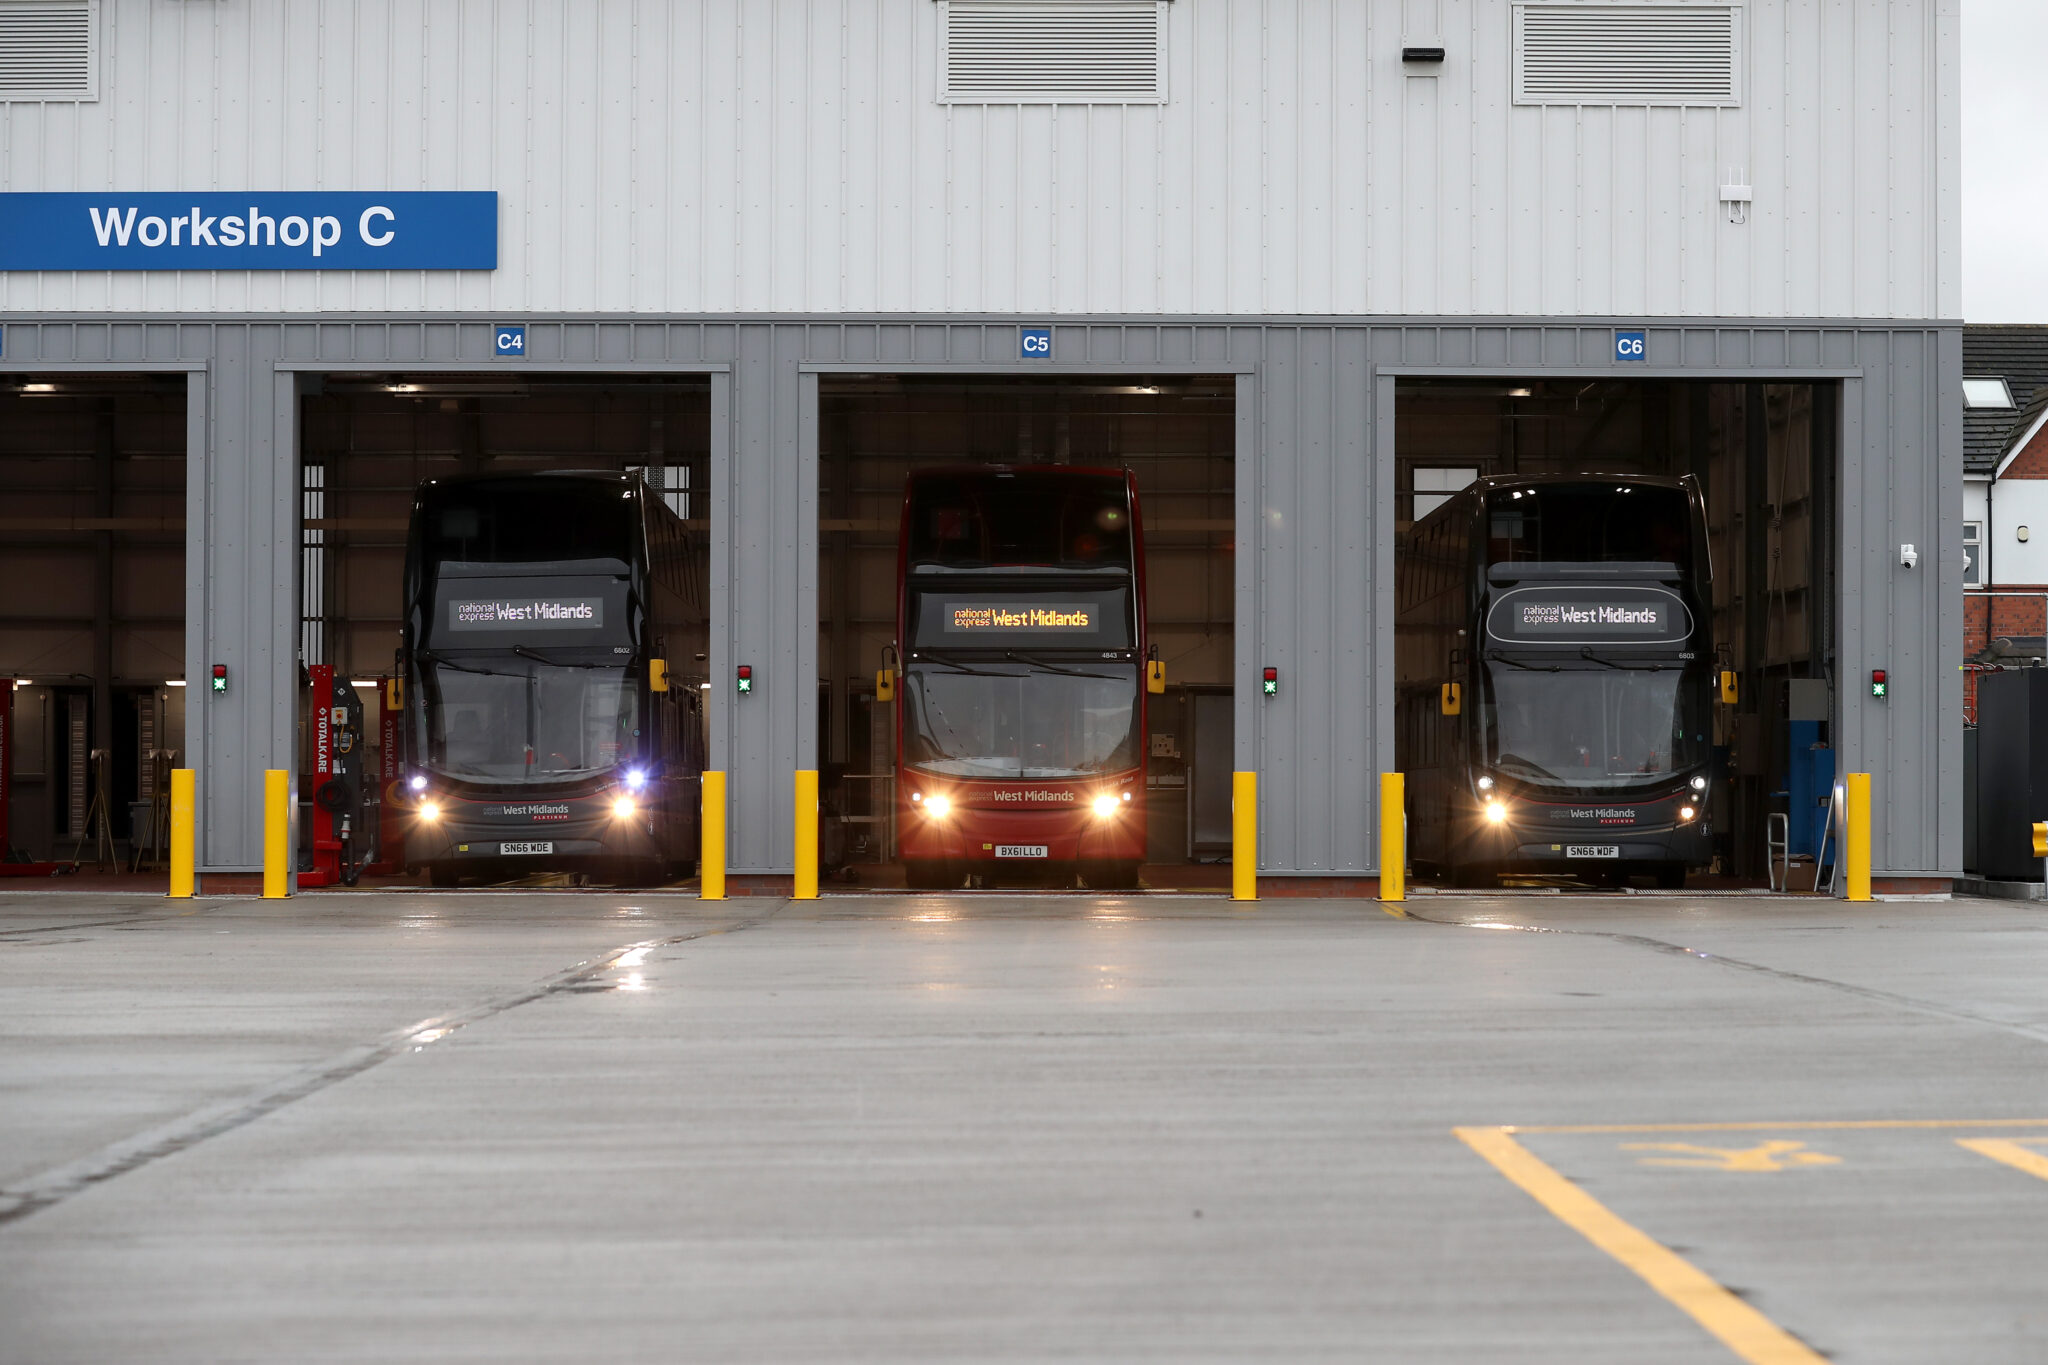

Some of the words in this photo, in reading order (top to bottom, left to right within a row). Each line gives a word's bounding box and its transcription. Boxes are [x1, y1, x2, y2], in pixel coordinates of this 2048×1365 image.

[89, 207, 341, 256] Workshop
[359, 206, 395, 246] C
[498, 333, 522, 349] C4
[1023, 336, 1048, 351] C5
[1618, 339, 1642, 354] C6
[458, 602, 494, 612] national
[496, 603, 532, 620] West
[534, 602, 593, 619] Midlands
[1523, 605, 1560, 615] national
[458, 612, 495, 623] express
[954, 608, 990, 618] national
[992, 609, 1028, 626] West
[1030, 609, 1088, 626] Midlands
[1561, 606, 1596, 623] West
[1599, 606, 1656, 623] Midlands
[954, 618, 990, 628] express
[1523, 615, 1559, 625] express
[318, 716, 327, 773] TOTALKARE
[385, 728, 393, 778] TOTALKARE
[994, 790, 1022, 801] West
[1025, 790, 1074, 801] Midlands
[503, 805, 526, 815] West
[528, 804, 569, 814] Midlands
[1570, 809, 1593, 818] West
[1595, 808, 1635, 817] Midlands
[504, 844, 528, 853] SN66
[530, 843, 548, 852] WDE
[1570, 847, 1594, 856] SN66
[1597, 847, 1615, 855] WDF
